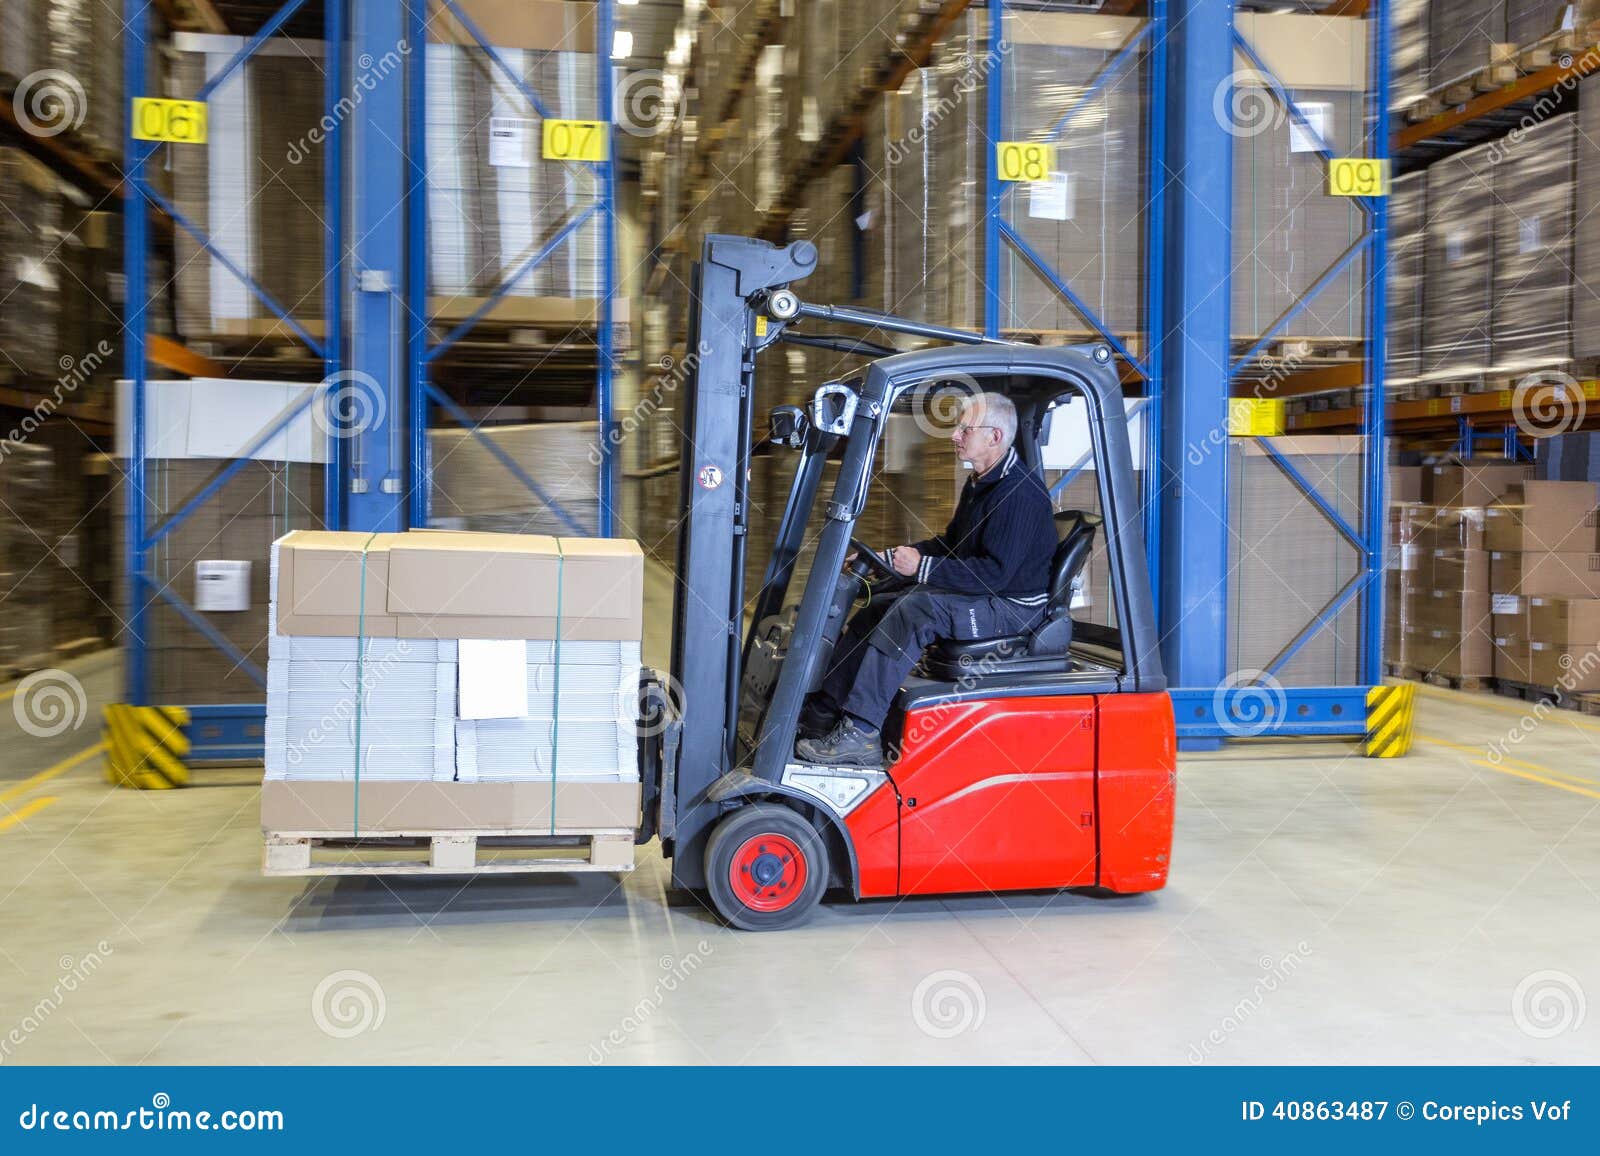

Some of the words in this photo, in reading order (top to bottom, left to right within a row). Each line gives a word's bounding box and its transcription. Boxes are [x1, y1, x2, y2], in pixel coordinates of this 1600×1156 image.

[140, 101, 192, 139] 06
[550, 122, 596, 158] 07
[1003, 145, 1043, 180] 08
[1335, 162, 1375, 194] 09
